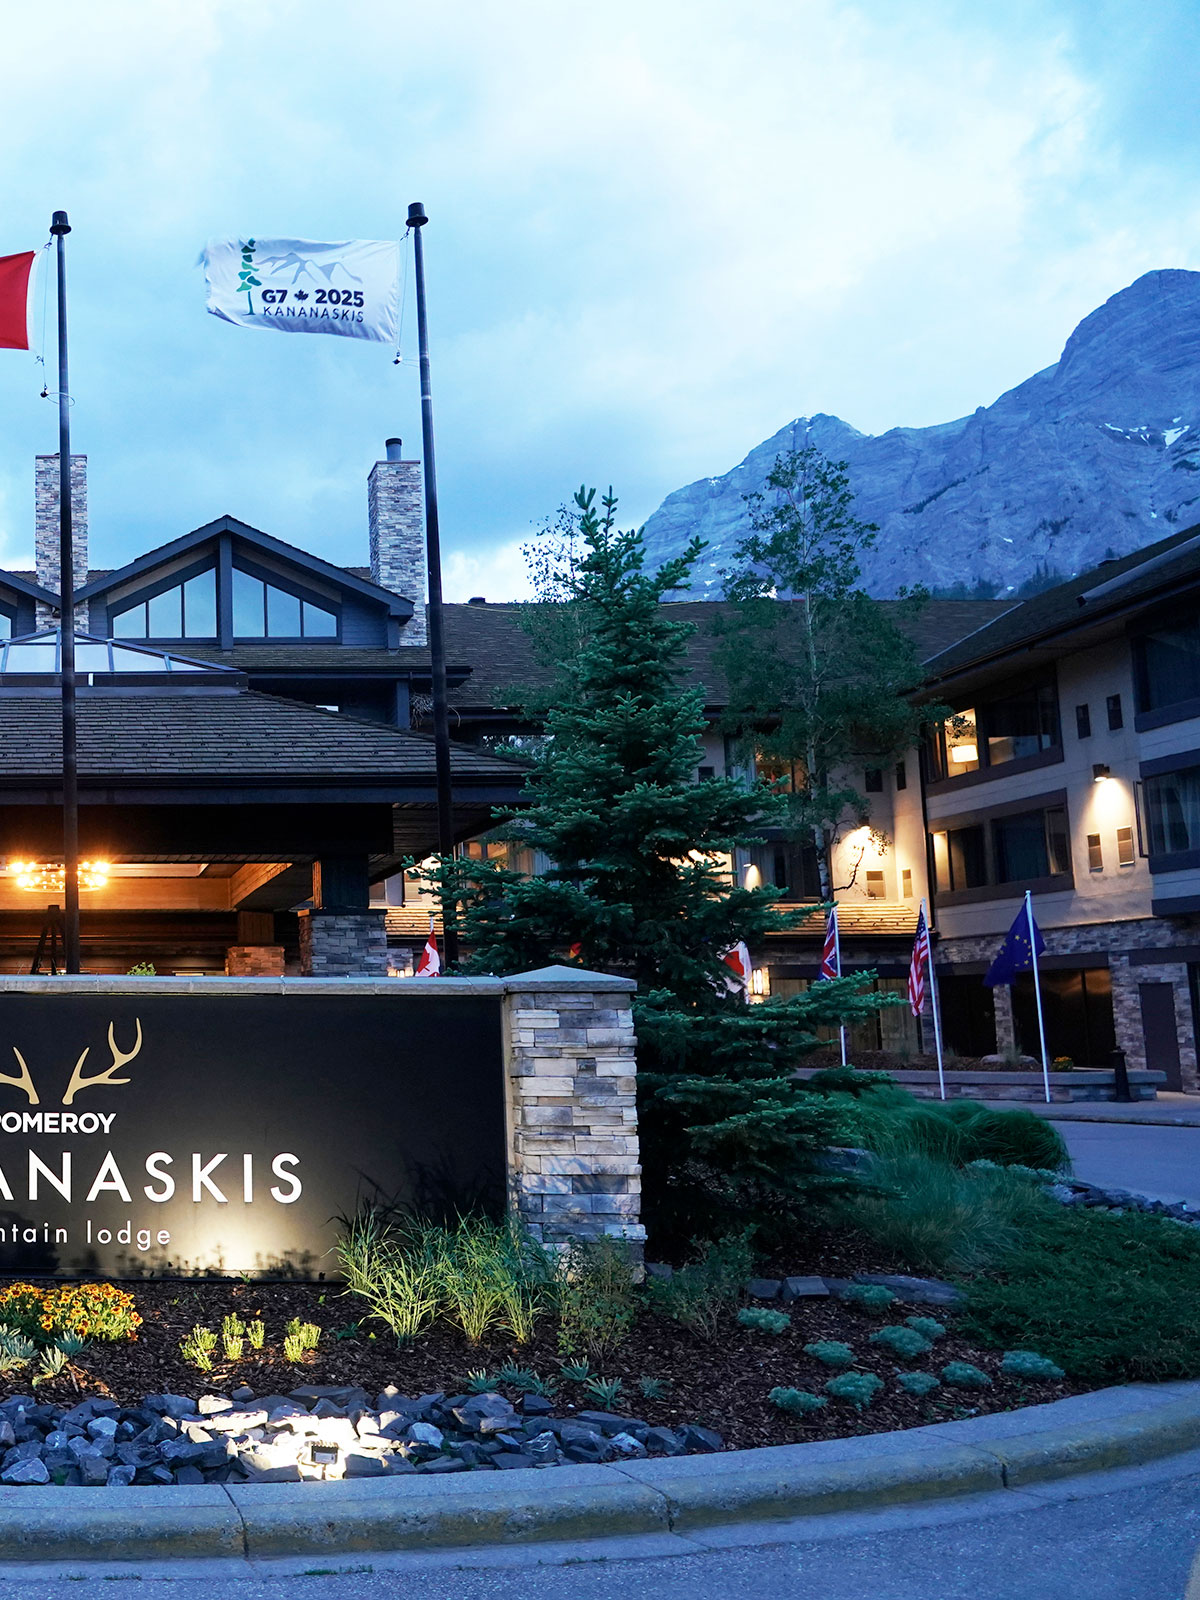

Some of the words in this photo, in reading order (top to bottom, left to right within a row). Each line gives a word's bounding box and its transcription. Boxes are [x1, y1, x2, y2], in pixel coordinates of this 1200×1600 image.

[261, 289, 288, 304] G7
[314, 289, 365, 308] 2025
[262, 305, 365, 323] KANANASKIS
[86, 1220, 171, 1252] lodge
